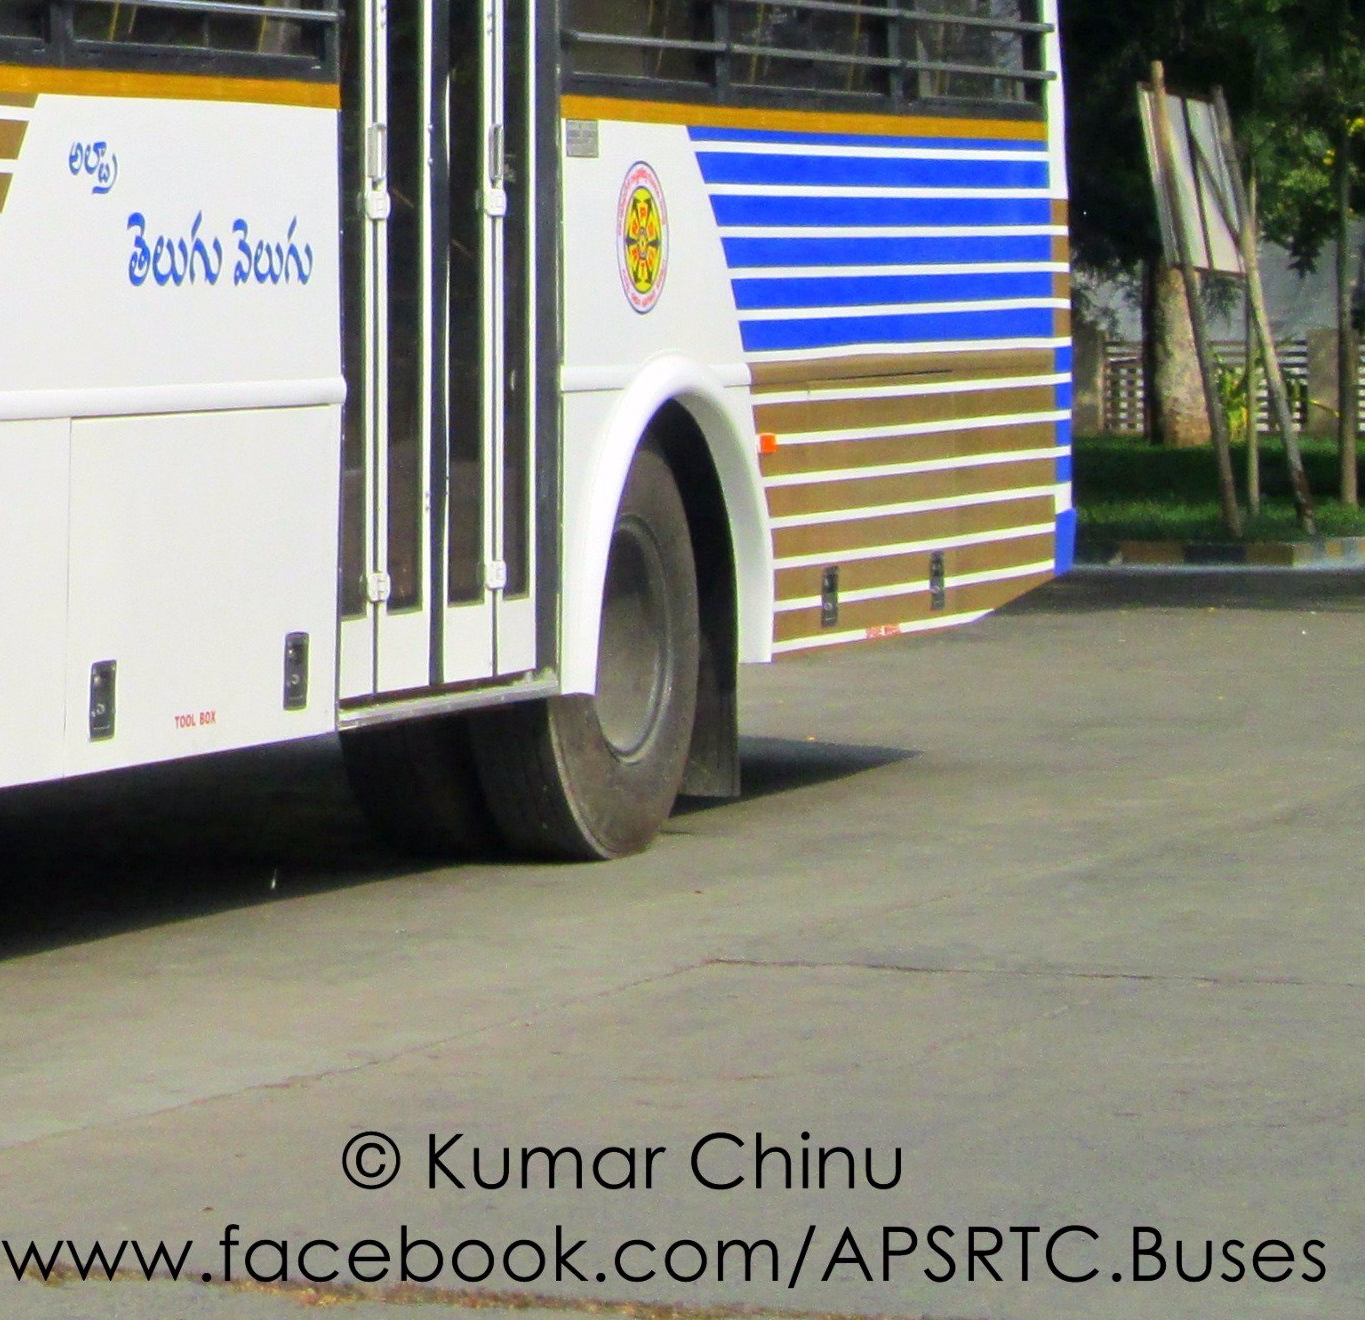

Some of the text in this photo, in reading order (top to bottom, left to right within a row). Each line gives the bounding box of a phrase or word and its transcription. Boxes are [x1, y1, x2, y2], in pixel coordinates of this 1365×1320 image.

[126, 209, 314, 287] తెలుగు వెలుగు
[174, 710, 217, 729] TOOL BOX
